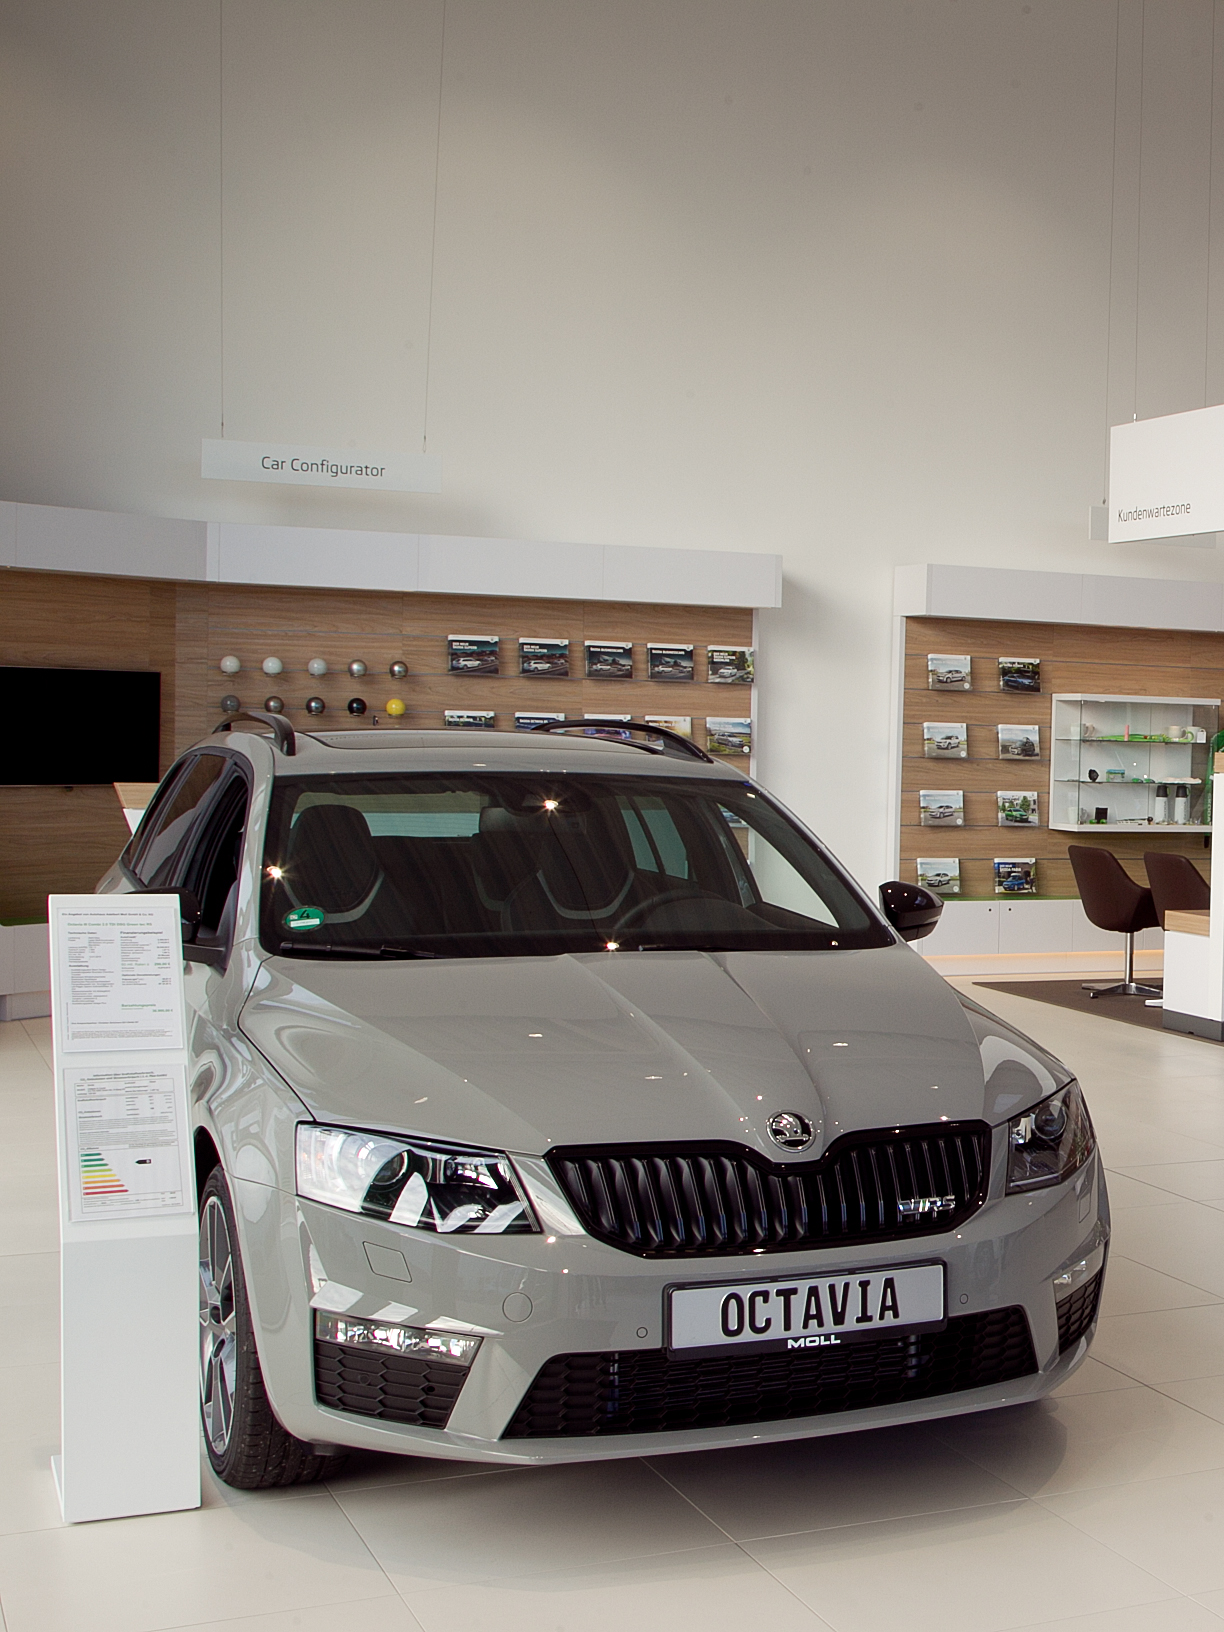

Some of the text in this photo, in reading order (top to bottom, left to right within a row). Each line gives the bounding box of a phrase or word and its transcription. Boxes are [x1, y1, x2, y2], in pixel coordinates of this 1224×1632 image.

[261, 456, 386, 477] Car Configurator
[1117, 502, 1191, 522] Kundenwartezone
[300, 910, 310, 918] 4
[720, 1277, 900, 1337] OCTAVIA
[788, 1335, 841, 1349] MOLL
